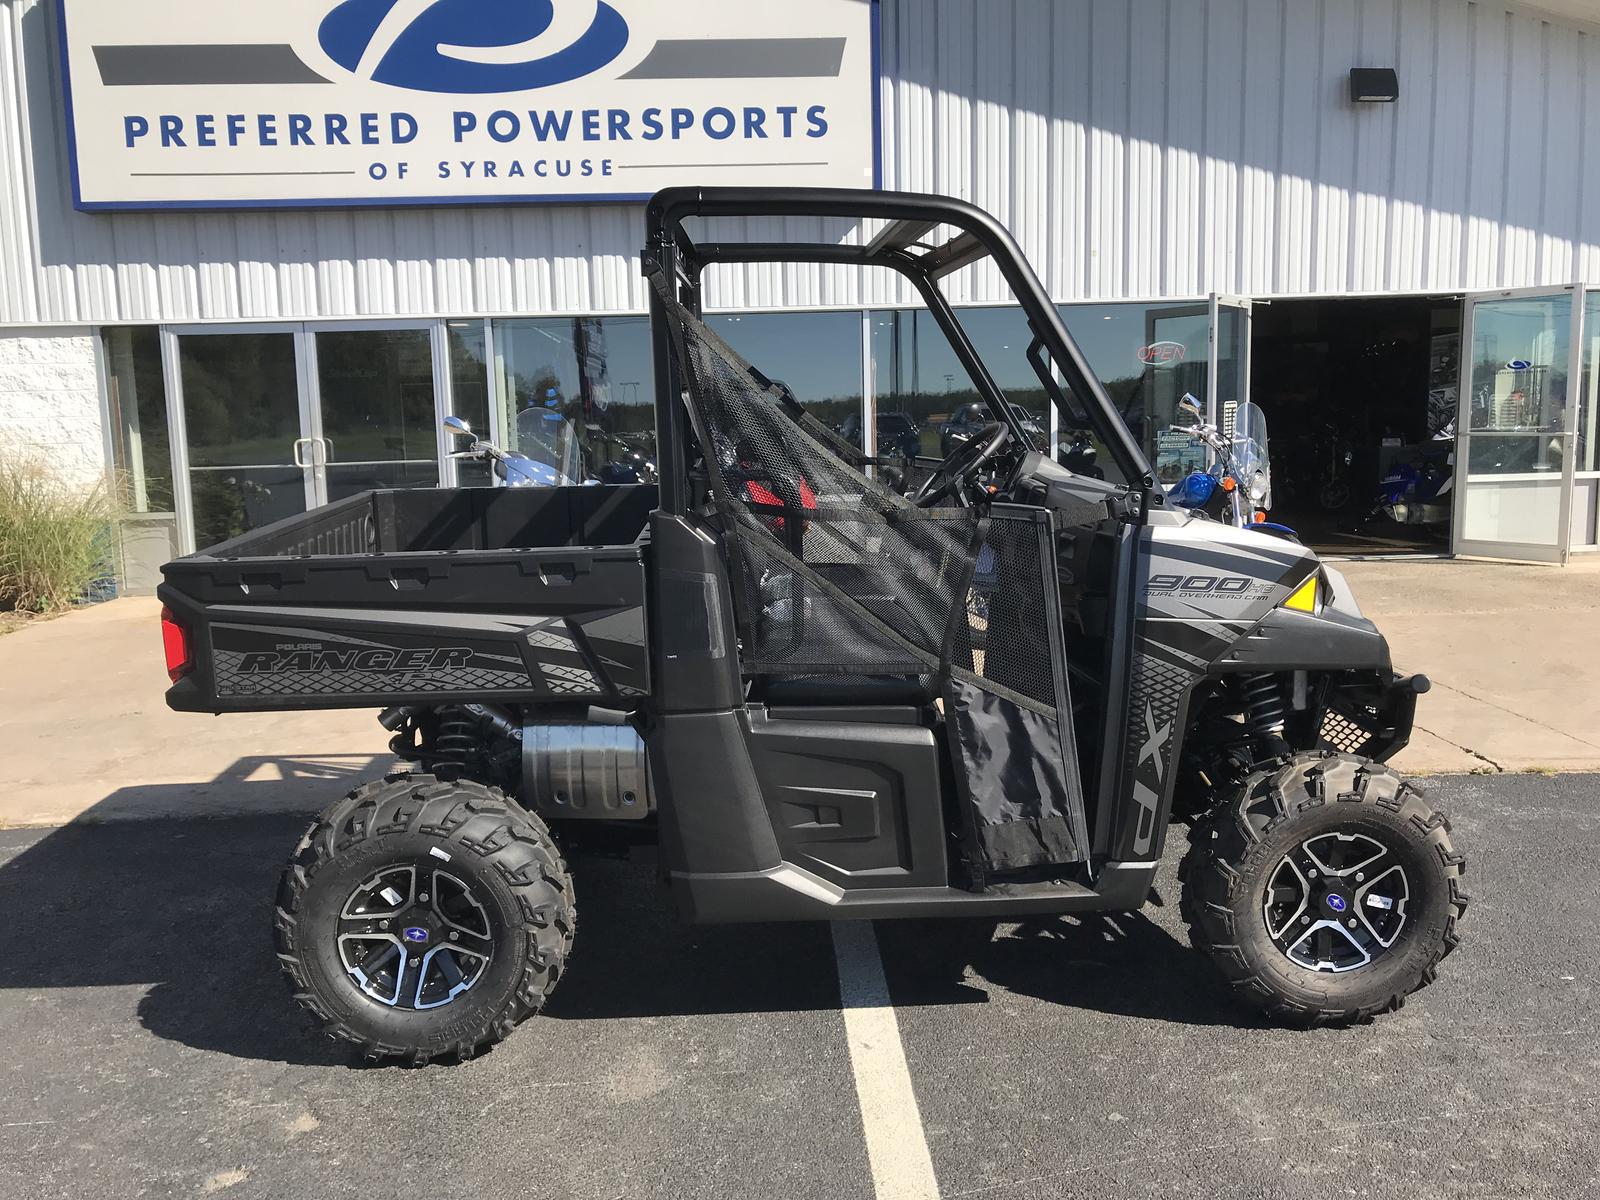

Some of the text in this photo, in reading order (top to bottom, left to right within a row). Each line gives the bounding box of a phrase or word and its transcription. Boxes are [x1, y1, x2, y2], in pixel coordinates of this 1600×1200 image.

[124, 104, 828, 148] PREFERRED POWERSPORTS
[368, 159, 613, 181] OF SYRACUSE
[1137, 345, 1186, 361] OPEN
[1143, 574, 1254, 594] 900
[275, 643, 322, 651] POLARIS
[235, 647, 474, 674] RANGER
[368, 672, 433, 685] XP
[1132, 697, 1172, 857] XP
